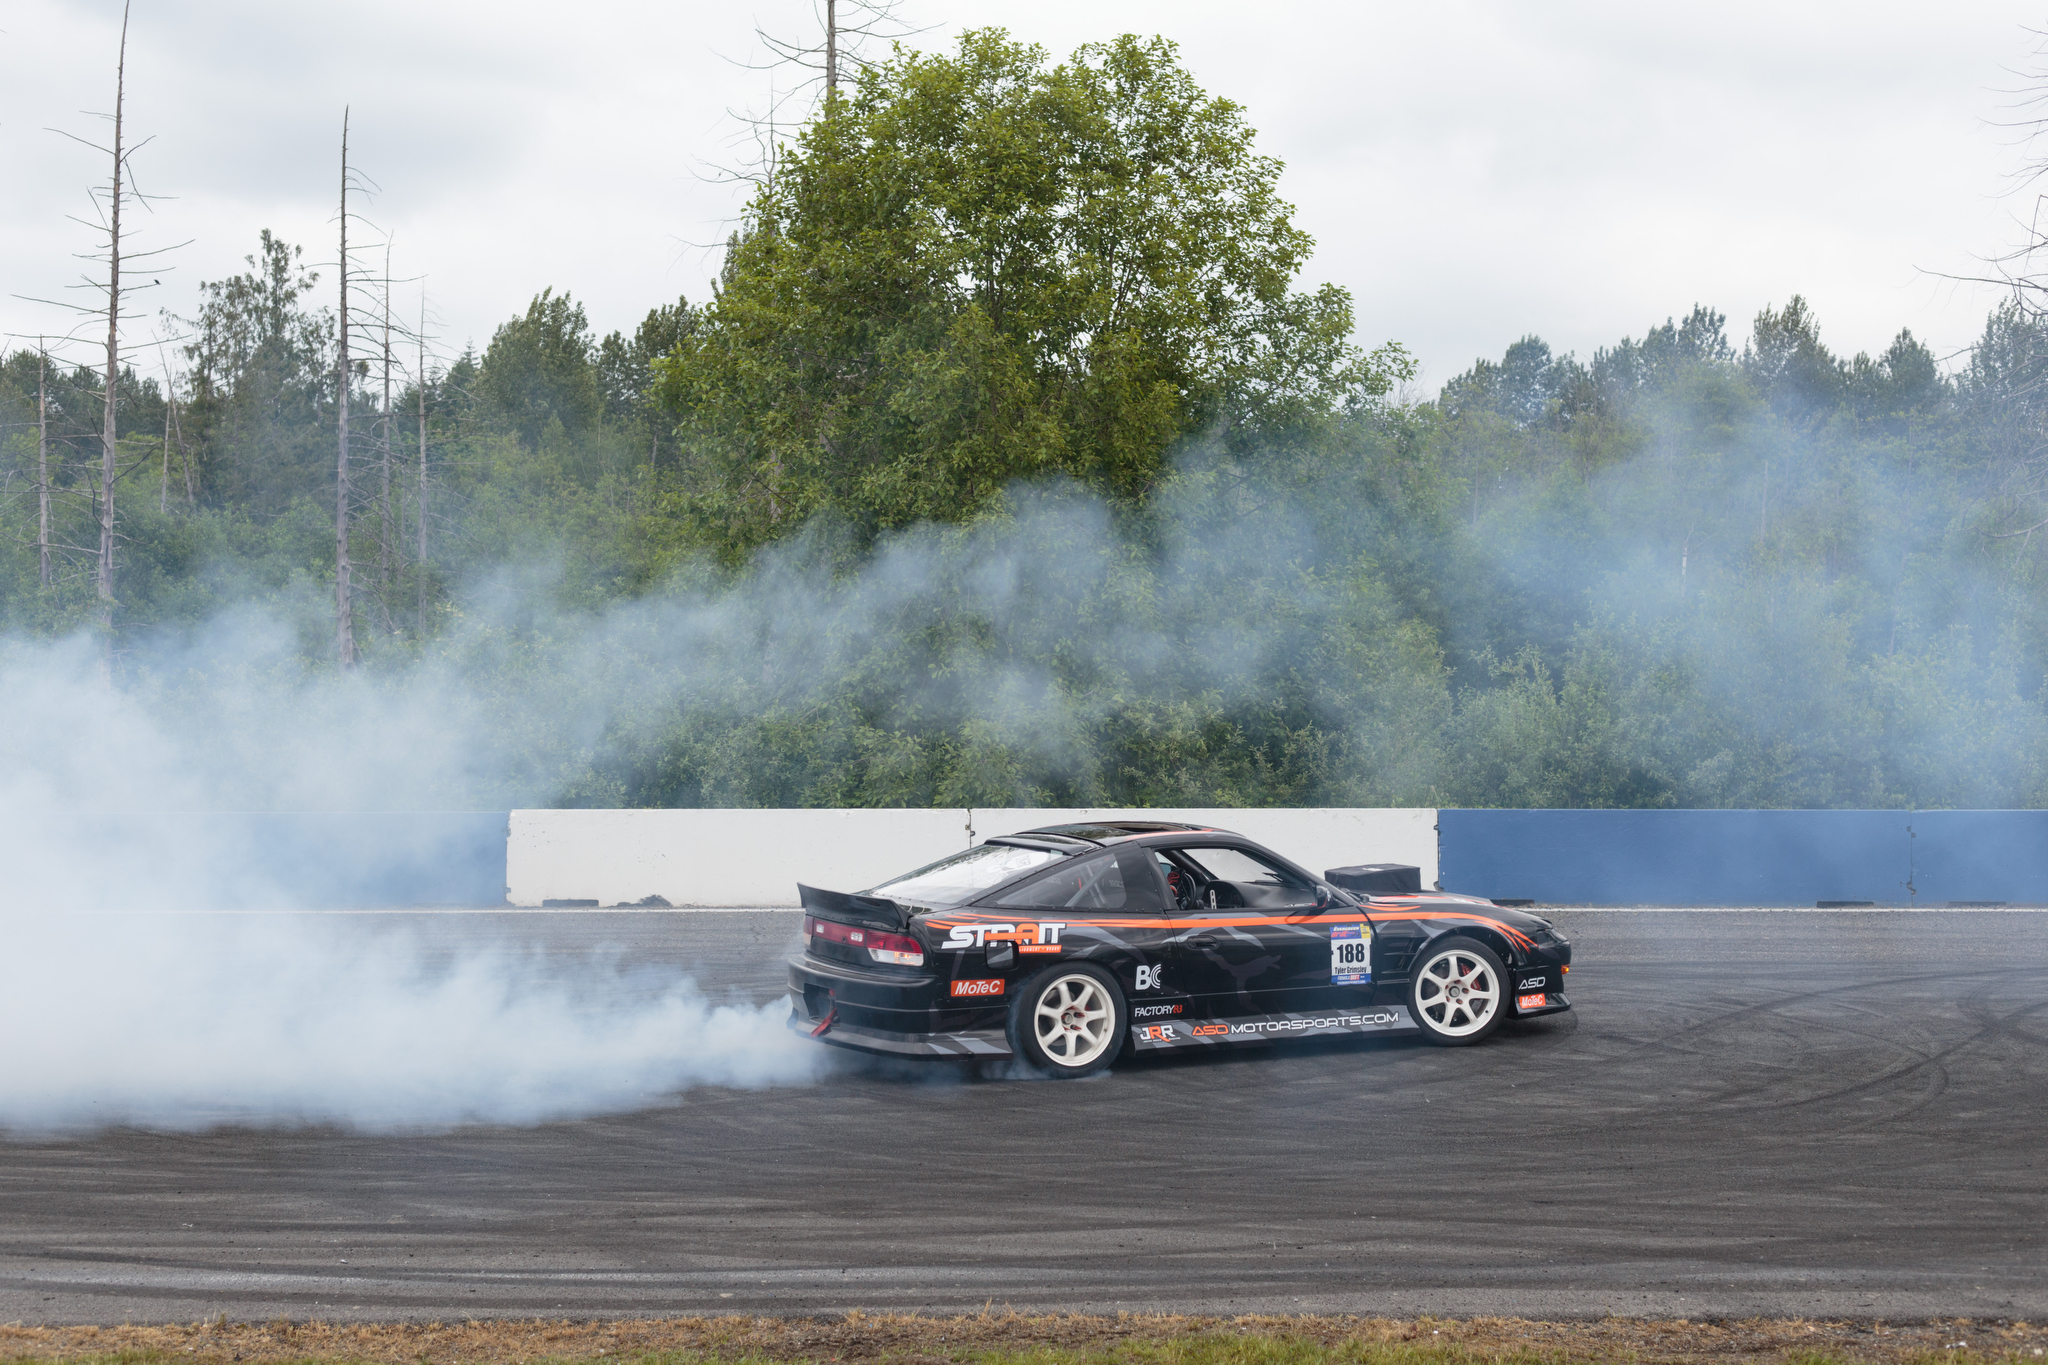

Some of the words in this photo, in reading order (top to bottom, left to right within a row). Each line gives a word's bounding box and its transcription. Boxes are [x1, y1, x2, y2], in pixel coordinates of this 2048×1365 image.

[941, 923, 1066, 949] STRAIT
[1336, 943, 1365, 964] 188
[1135, 964, 1161, 990] BC
[1519, 976, 1546, 990] ASD
[955, 980, 1001, 995] MoTeC
[1522, 995, 1543, 1007] MoTeC
[1140, 1024, 1176, 1042] JRR
[1192, 1025, 1229, 1036] ASD
[1231, 1012, 1399, 1034] MOTORSPORTS.COM
